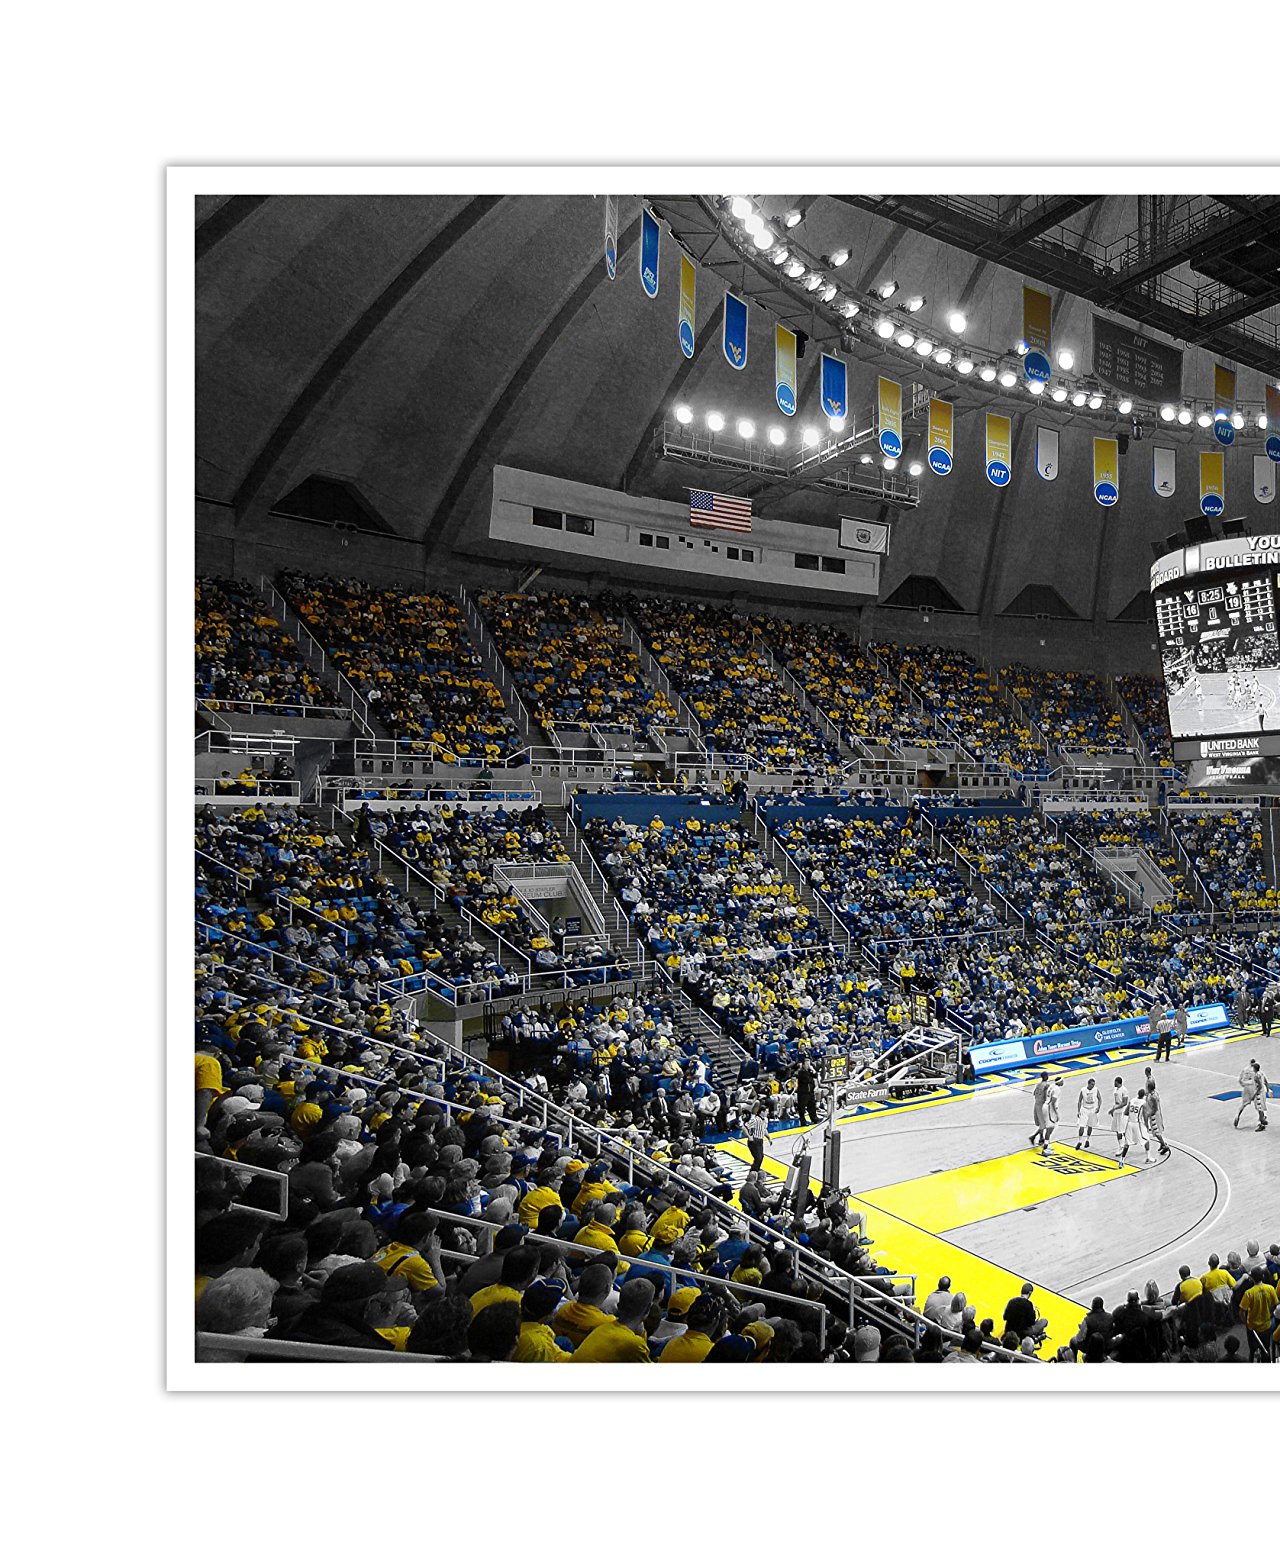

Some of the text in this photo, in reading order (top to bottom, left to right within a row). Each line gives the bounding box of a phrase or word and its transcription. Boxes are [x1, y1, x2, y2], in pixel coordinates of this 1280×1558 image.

[1133, 335, 1148, 348] NIT
[1028, 367, 1050, 379] NCAA
[779, 398, 795, 411] NCAA
[1217, 426, 1232, 438] NIT
[883, 443, 901, 453] NCAA
[932, 461, 951, 471] NCAA
[990, 468, 1007, 479] NIT
[1206, 552, 1279, 570] BULLETIN
[1155, 566, 1180, 587] BOARD
[1201, 589, 1220, 602] 8:25
[1228, 597, 1239, 608] 19
[1186, 605, 1196, 616] 16
[1208, 738, 1260, 751] UNITED BANK
[829, 1067, 843, 1078] 35
[1129, 1105, 1139, 1114] 35
